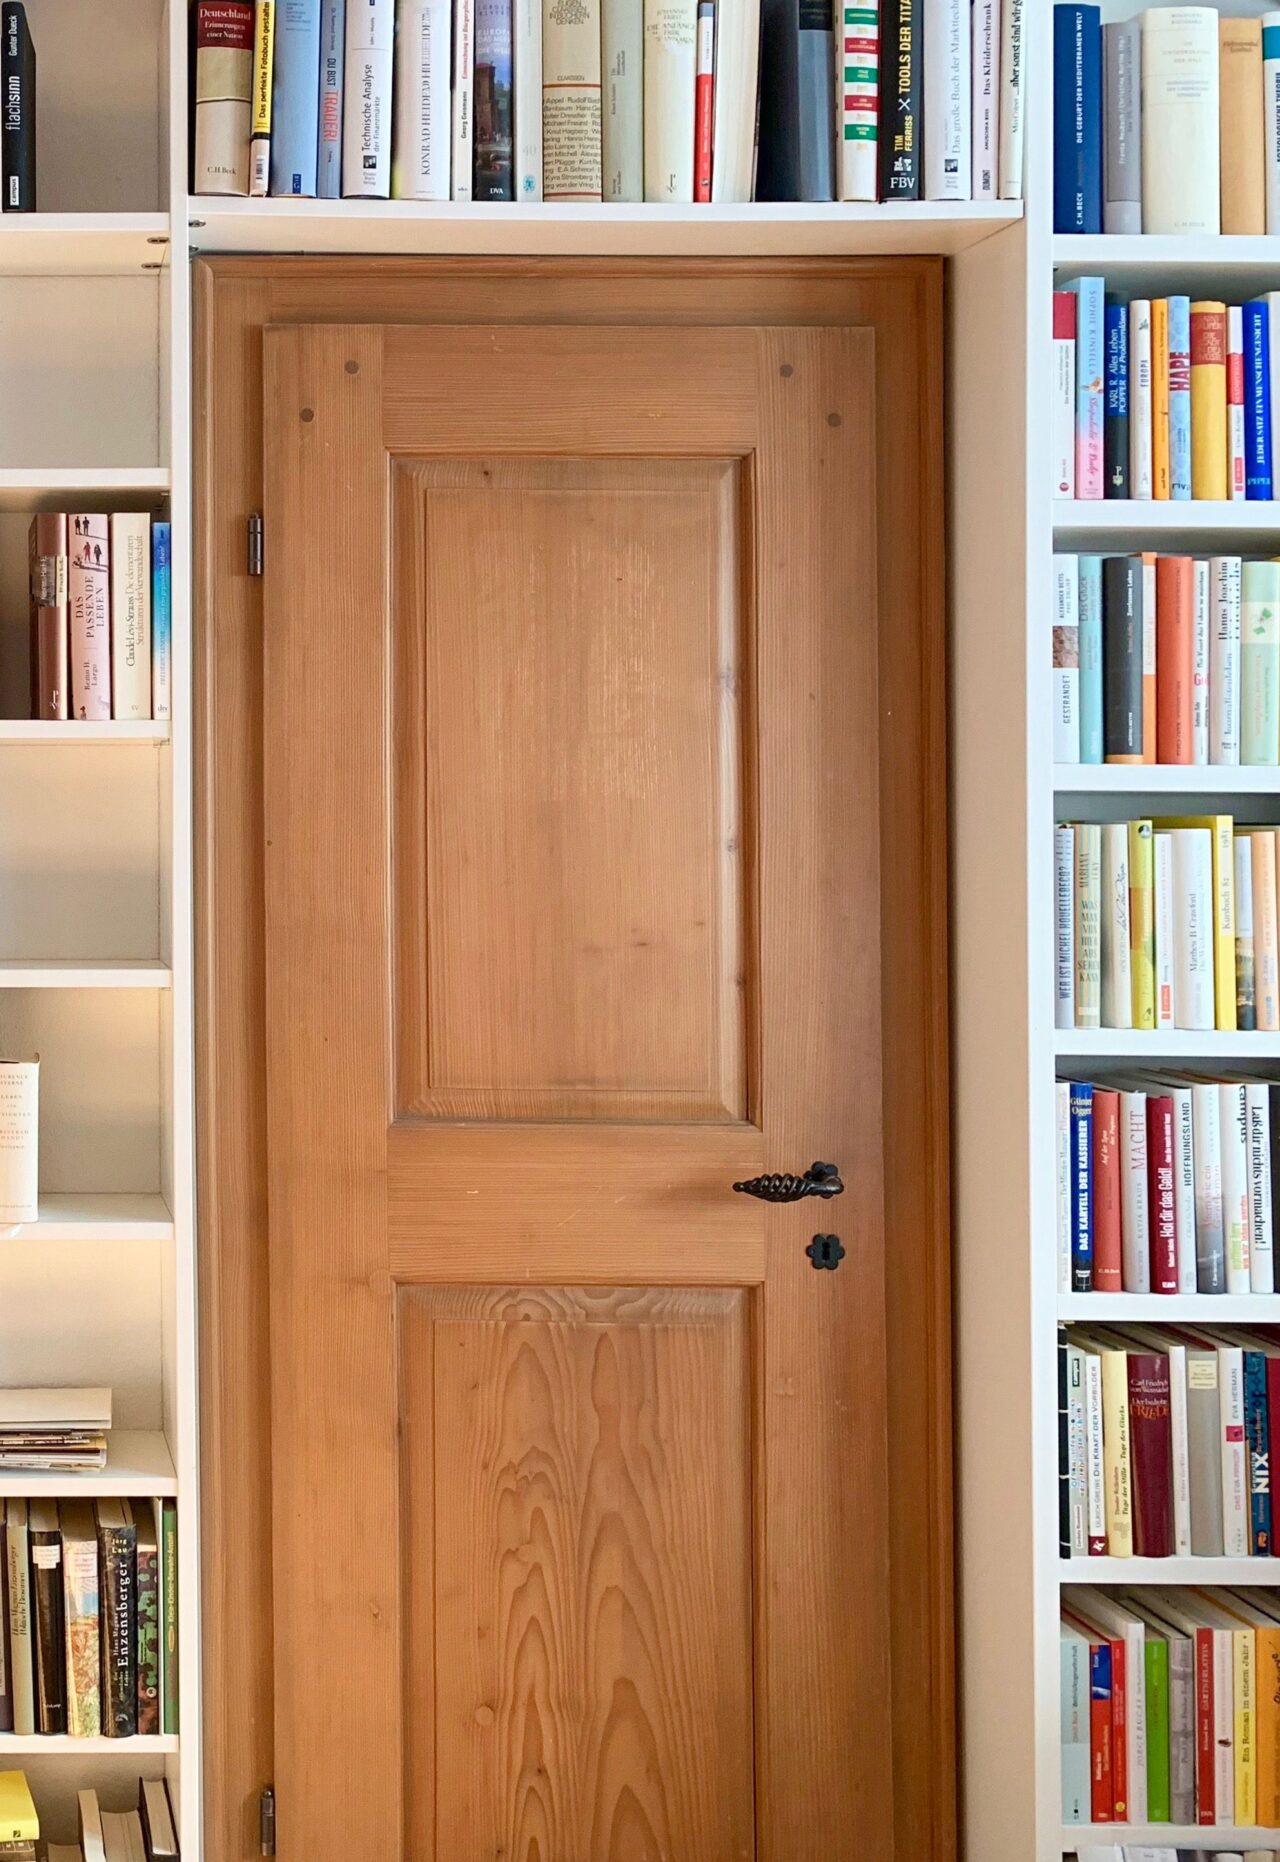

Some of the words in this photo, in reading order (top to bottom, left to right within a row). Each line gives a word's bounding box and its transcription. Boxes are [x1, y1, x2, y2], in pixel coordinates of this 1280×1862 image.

[899, 27, 911, 50] DER
[363, 64, 373, 97] Analyse
[899, 55, 911, 94] TOOLS
[5, 76, 20, 130] flachsinn
[362, 102, 371, 151] Technische
[895, 135, 903, 151] TIM
[904, 115, 913, 151] FERRISS
[1169, 352, 1190, 391] HAPE
[75, 596, 84, 618] DAS
[85, 576, 94, 638] PASSENDE
[96, 587, 104, 627] LEBEN
[1062, 674, 1071, 724] GESTRANDET
[1059, 931, 1070, 962] MICHEL
[1059, 966, 1070, 978] IST
[1059, 981, 1071, 999] WER
[1078, 1120, 1087, 1168] KASSIERER
[1130, 1110, 1144, 1170] MACHT
[1182, 1102, 1192, 1186] HOFFNUNGSLAND
[1078, 1172, 1088, 1189] DER
[1079, 1192, 1088, 1230] KARTELL
[1079, 1233, 1088, 1250] DAS
[1231, 1405, 1239, 1419] EVA
[1254, 1452, 1269, 1493] NIX
[117, 1562, 130, 1666] Enzensberger
